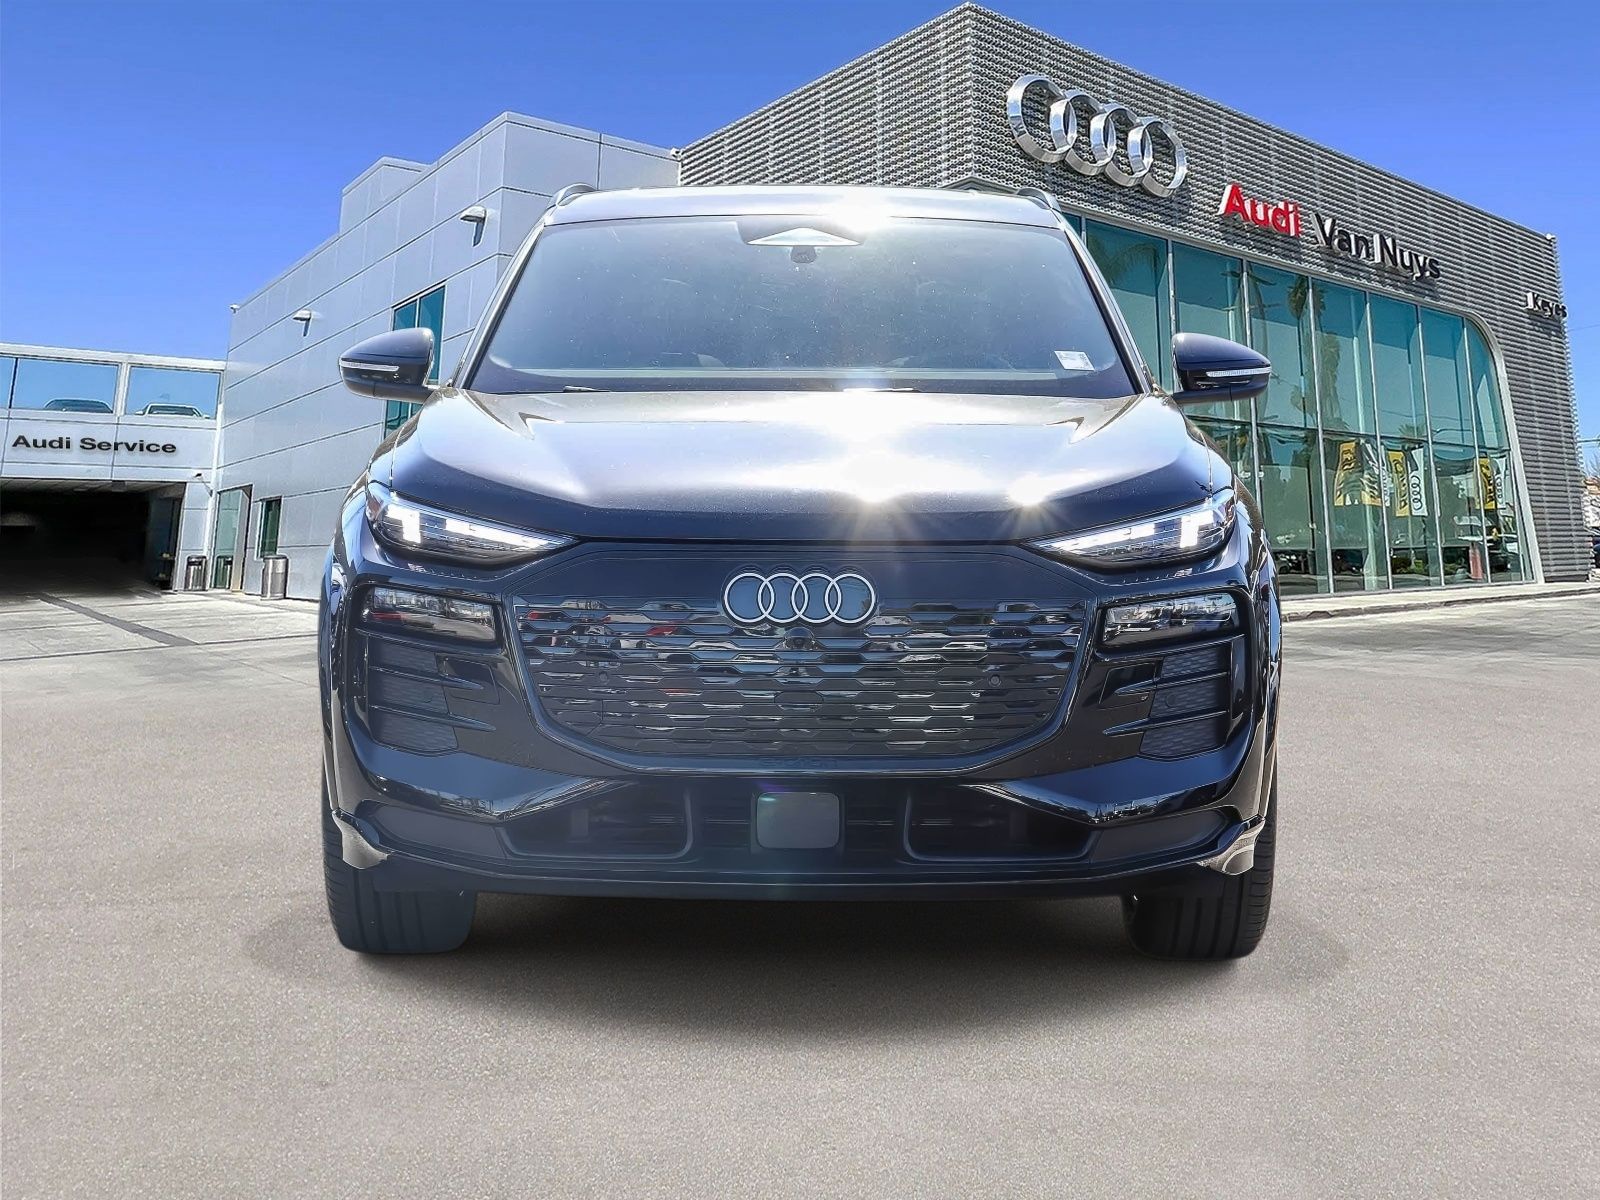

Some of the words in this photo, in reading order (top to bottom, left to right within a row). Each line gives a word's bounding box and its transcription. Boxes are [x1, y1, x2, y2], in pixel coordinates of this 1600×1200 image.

[1220, 184, 1300, 237] Audi
[1310, 213, 1371, 259] Van
[1374, 233, 1440, 280] Nuys
[12, 435, 71, 449] Audi
[79, 437, 177, 453] Service
